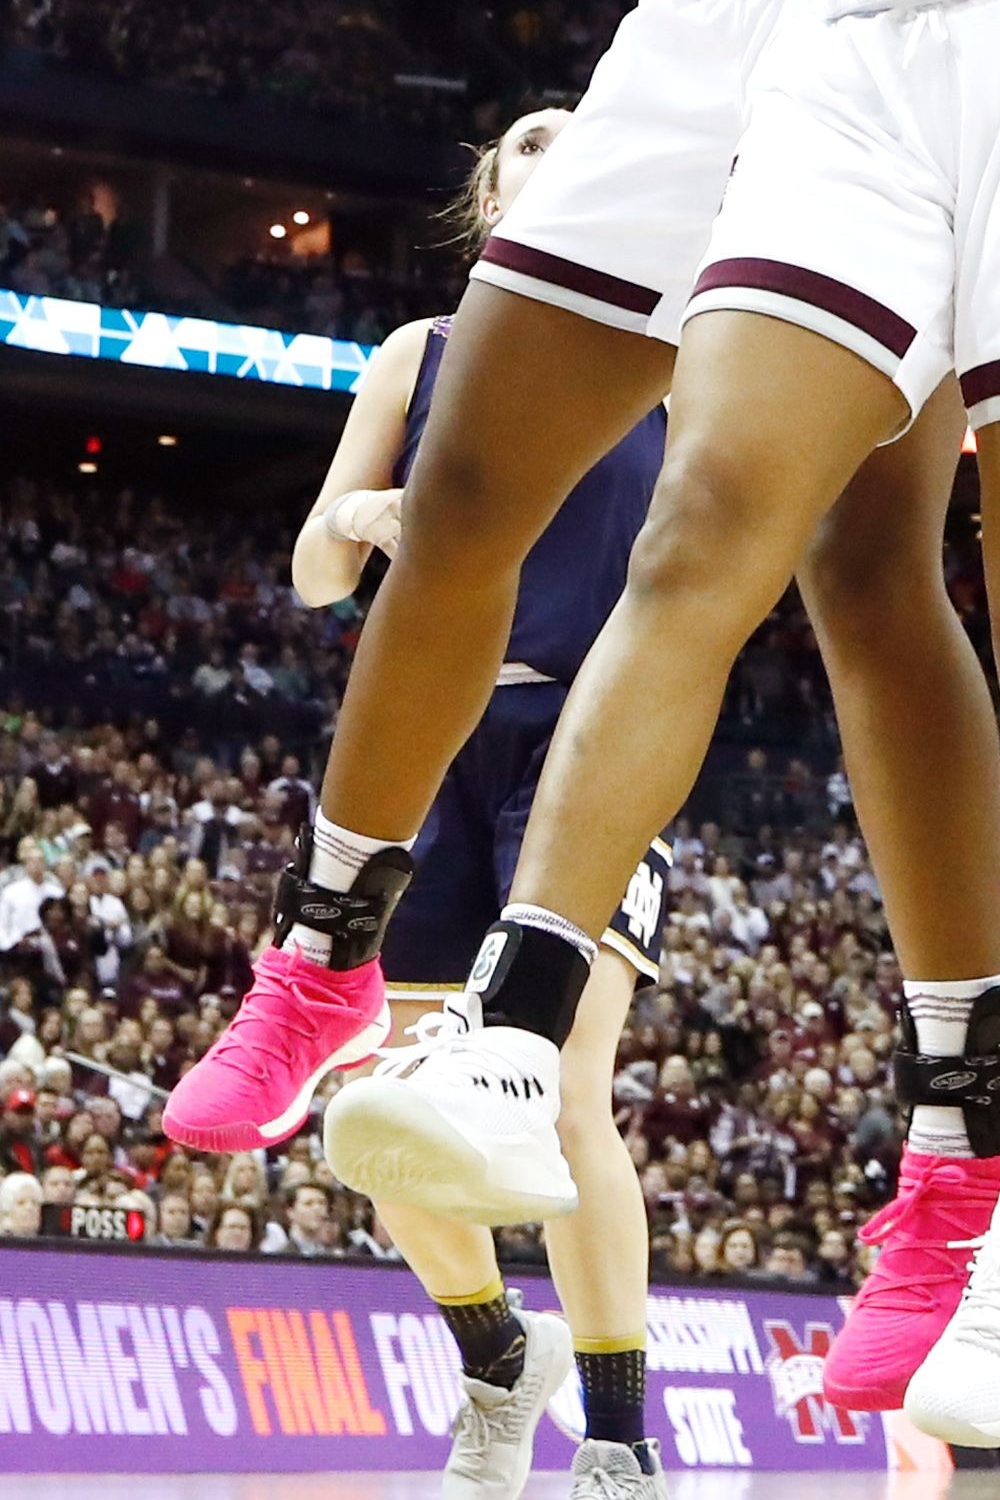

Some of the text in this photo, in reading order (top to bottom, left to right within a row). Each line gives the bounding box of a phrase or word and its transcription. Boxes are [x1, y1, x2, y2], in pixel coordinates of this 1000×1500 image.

[71, 1206, 127, 1239] POSS
[0, 1298, 464, 1437] WOMEN'S FINAL FOU
